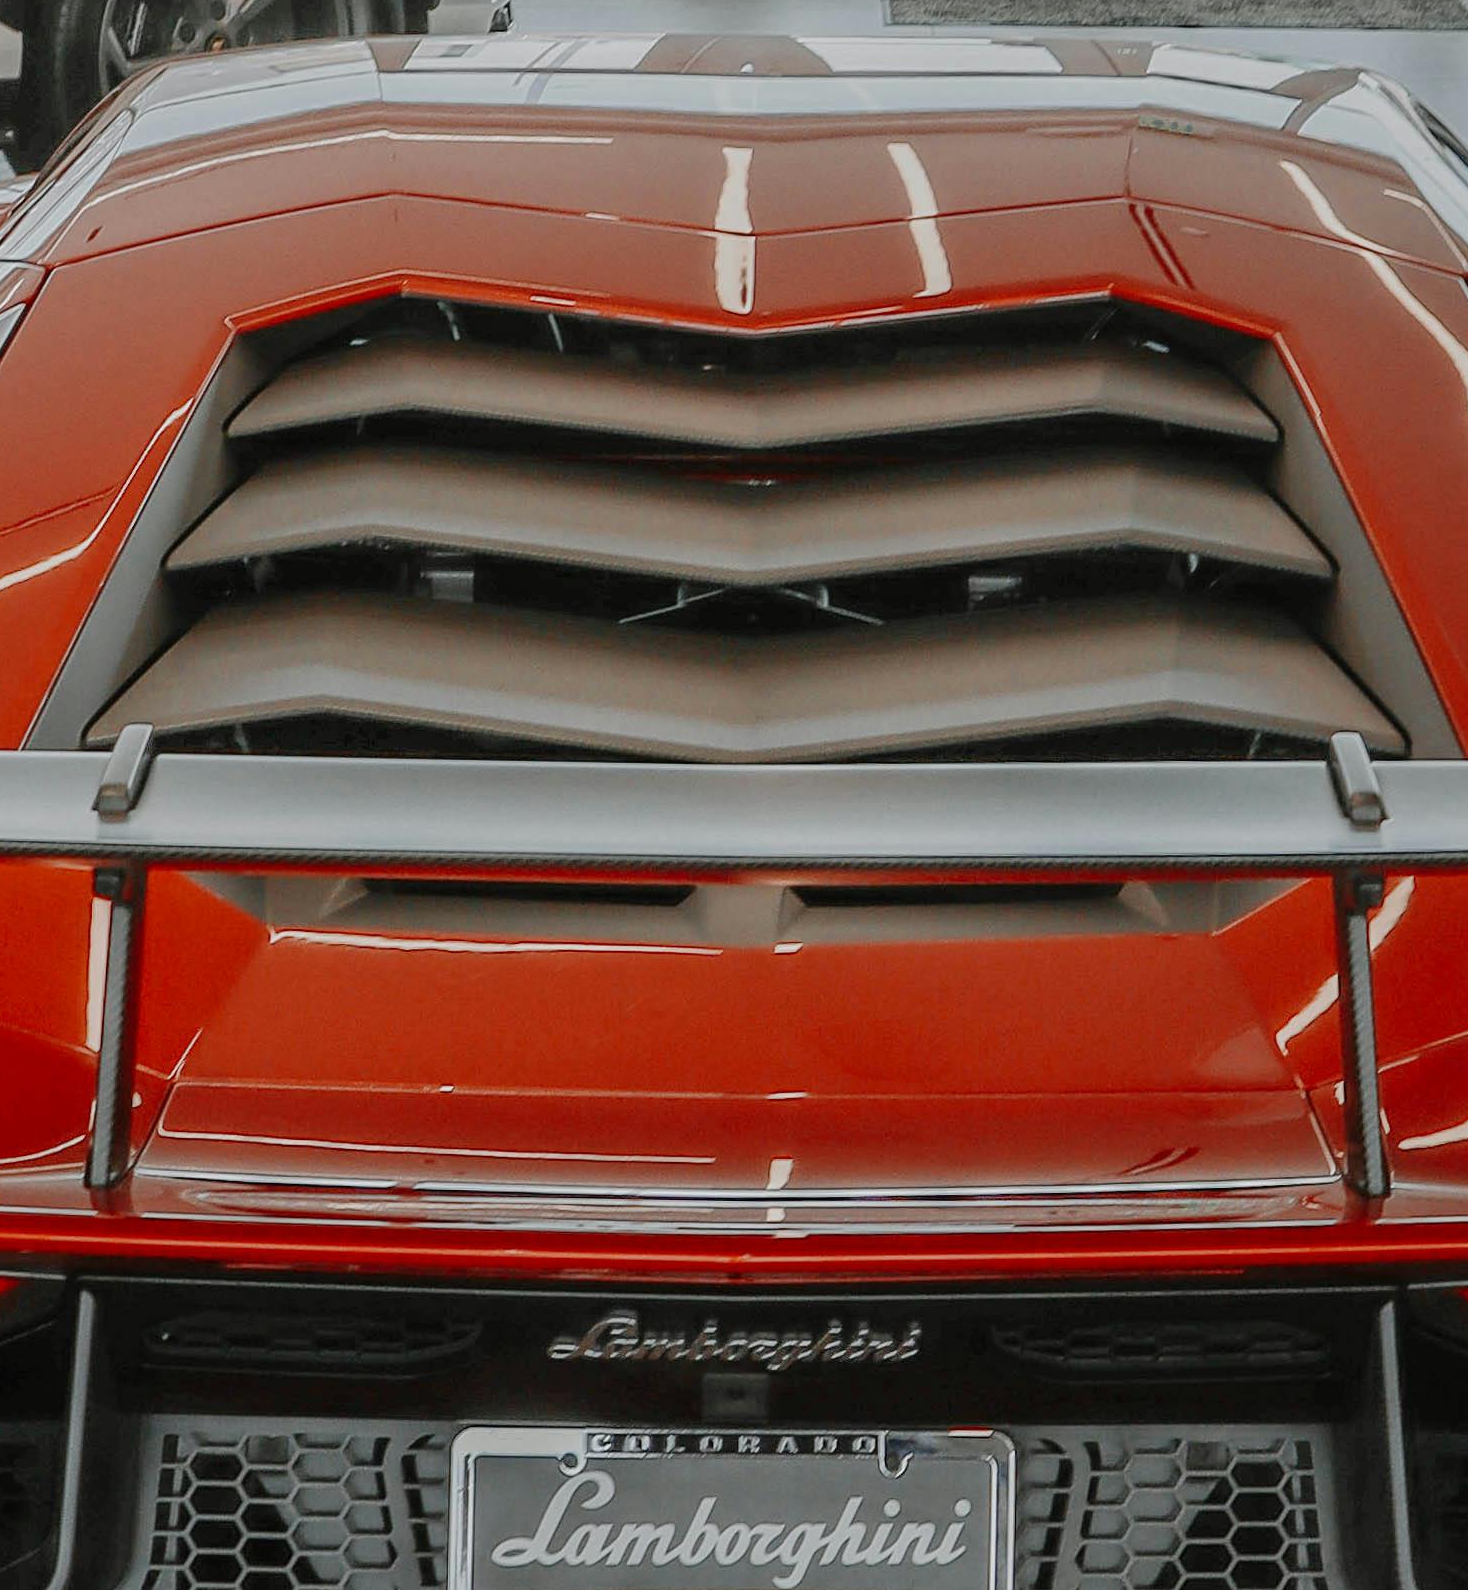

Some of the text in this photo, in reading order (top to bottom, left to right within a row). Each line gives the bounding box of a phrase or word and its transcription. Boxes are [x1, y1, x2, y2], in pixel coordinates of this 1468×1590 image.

[548, 1310, 921, 1371] Lamborghini
[589, 1433, 877, 1454] COLORADO
[491, 1470, 972, 1590] Lamborghini
